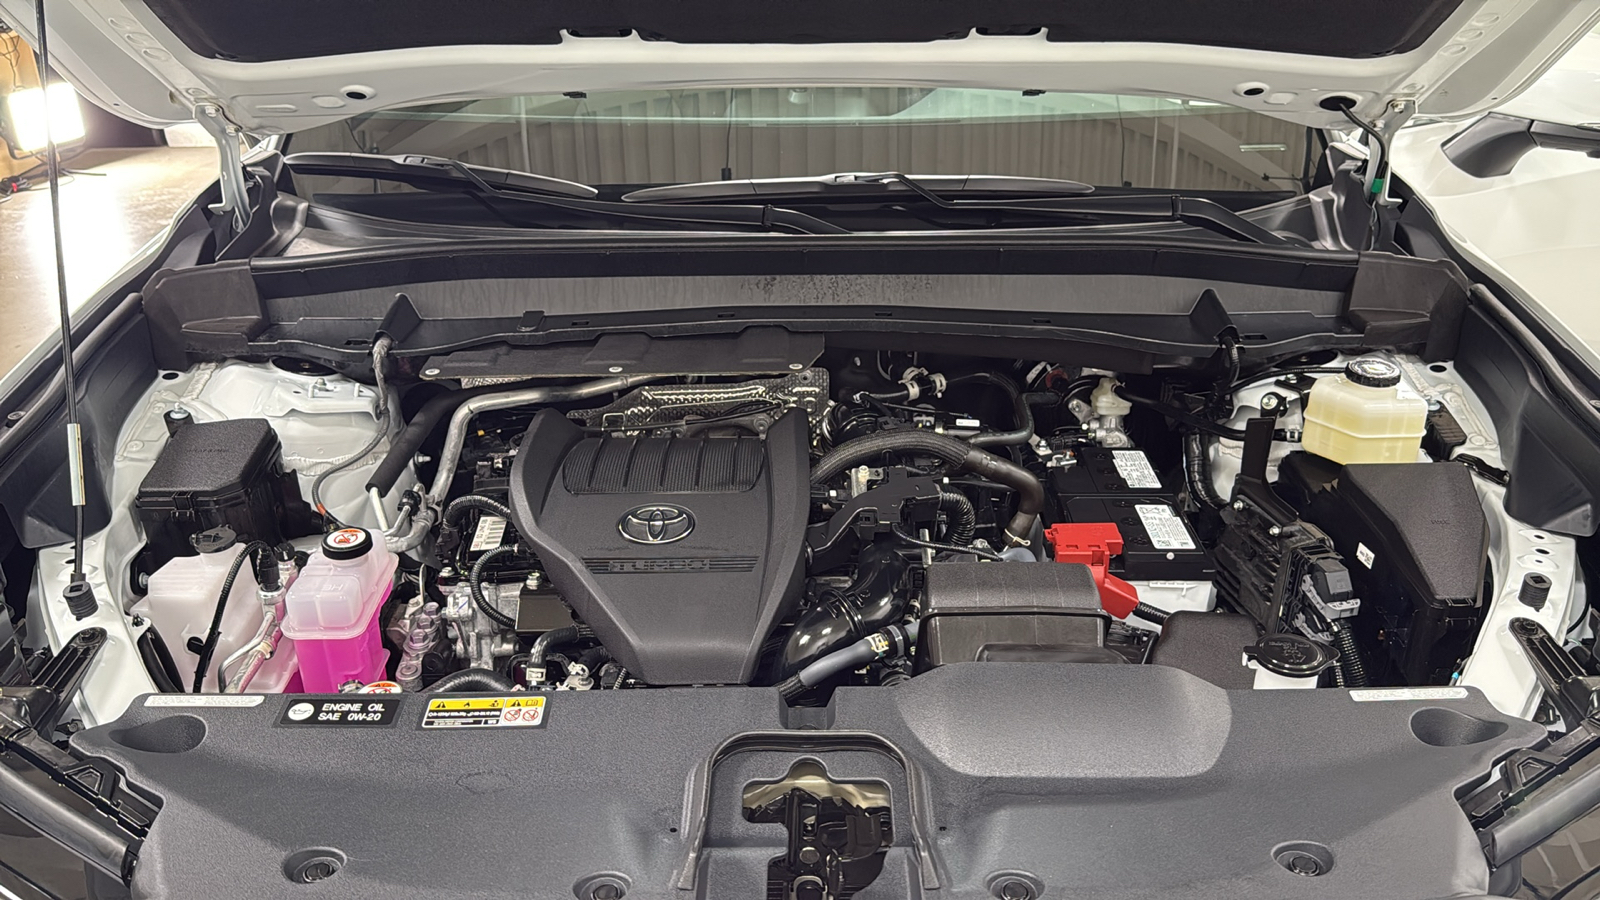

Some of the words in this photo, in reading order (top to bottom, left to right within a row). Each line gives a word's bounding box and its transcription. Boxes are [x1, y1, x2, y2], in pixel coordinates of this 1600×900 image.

[322, 703, 363, 712] ENGINE
[367, 703, 386, 712] OIL
[317, 712, 342, 721] SAE
[347, 712, 382, 721] 0W-20
